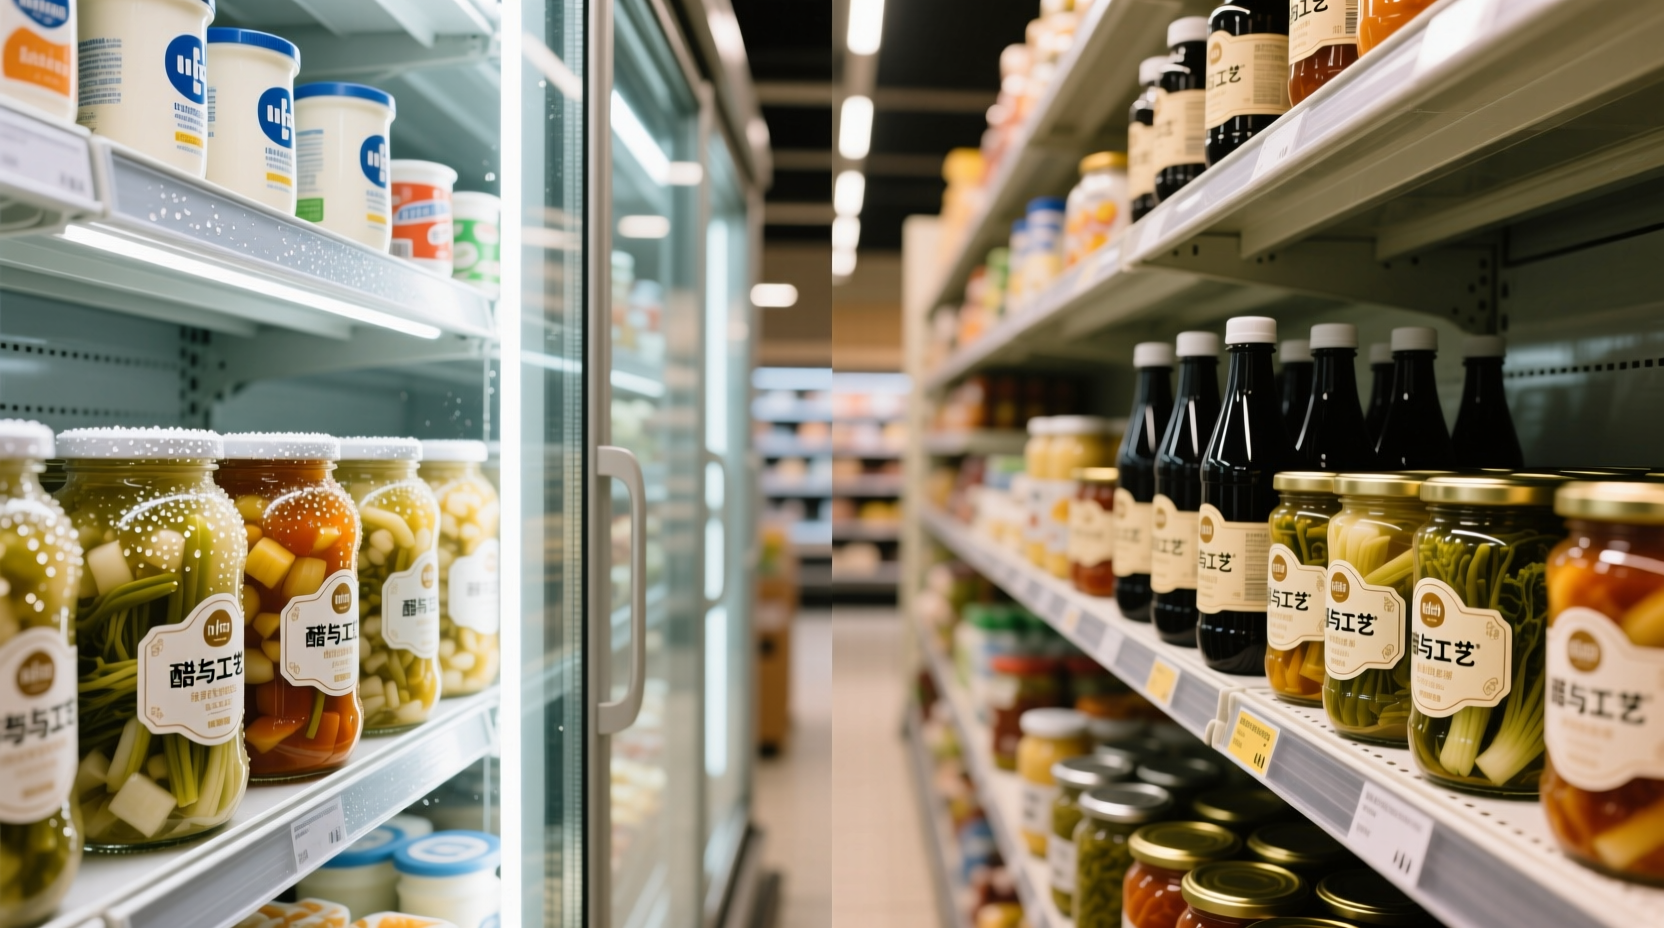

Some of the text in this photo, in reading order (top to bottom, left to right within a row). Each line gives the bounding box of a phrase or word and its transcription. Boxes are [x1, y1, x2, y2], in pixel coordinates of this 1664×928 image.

[1268, 587, 1309, 611] 与工艺
[1326, 608, 1375, 636] 与工艺
[169, 652, 243, 688] 醋与工艺
